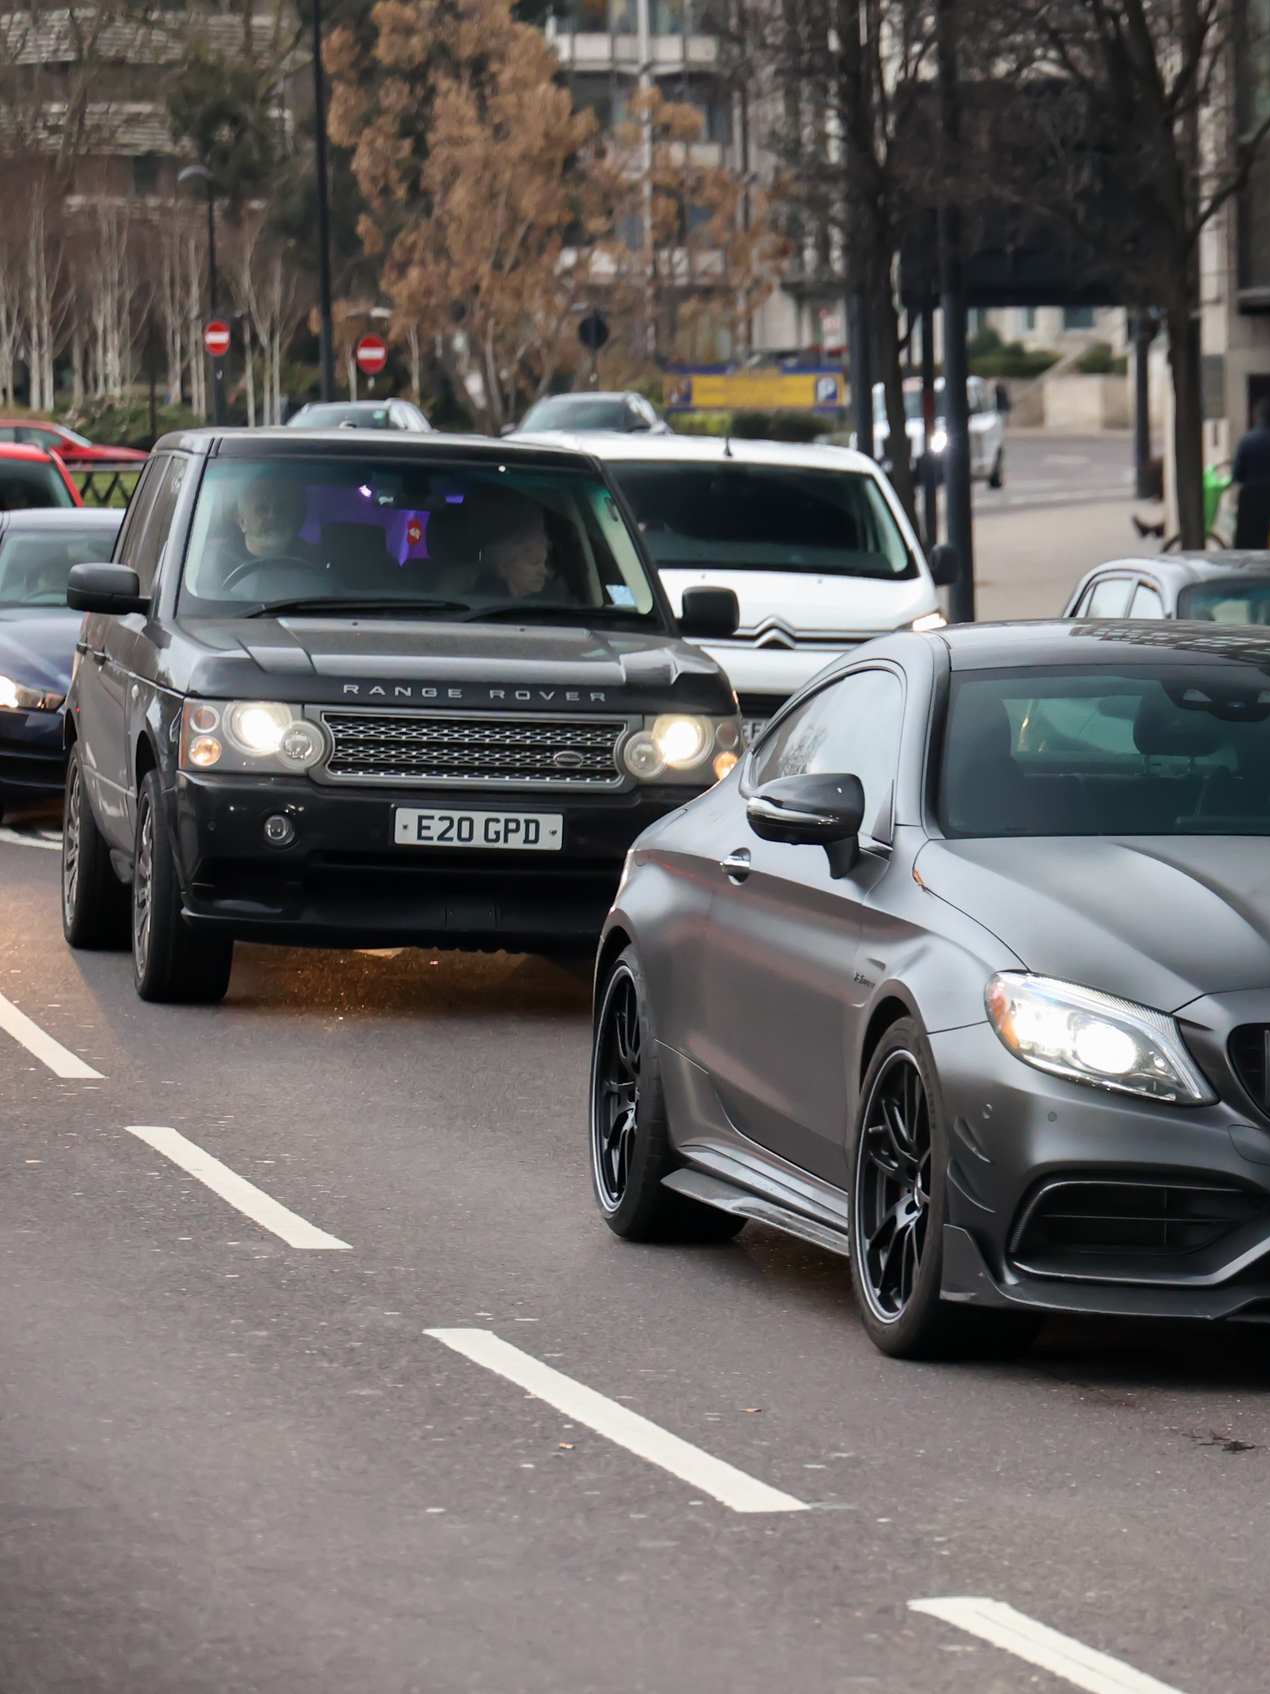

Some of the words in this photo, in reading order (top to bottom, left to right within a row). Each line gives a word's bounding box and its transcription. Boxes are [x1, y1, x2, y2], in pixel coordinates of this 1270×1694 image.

[342, 684, 463, 699] RANGE
[488, 690, 607, 702] ROVER
[415, 814, 475, 843] E20
[482, 817, 540, 845] GPD
